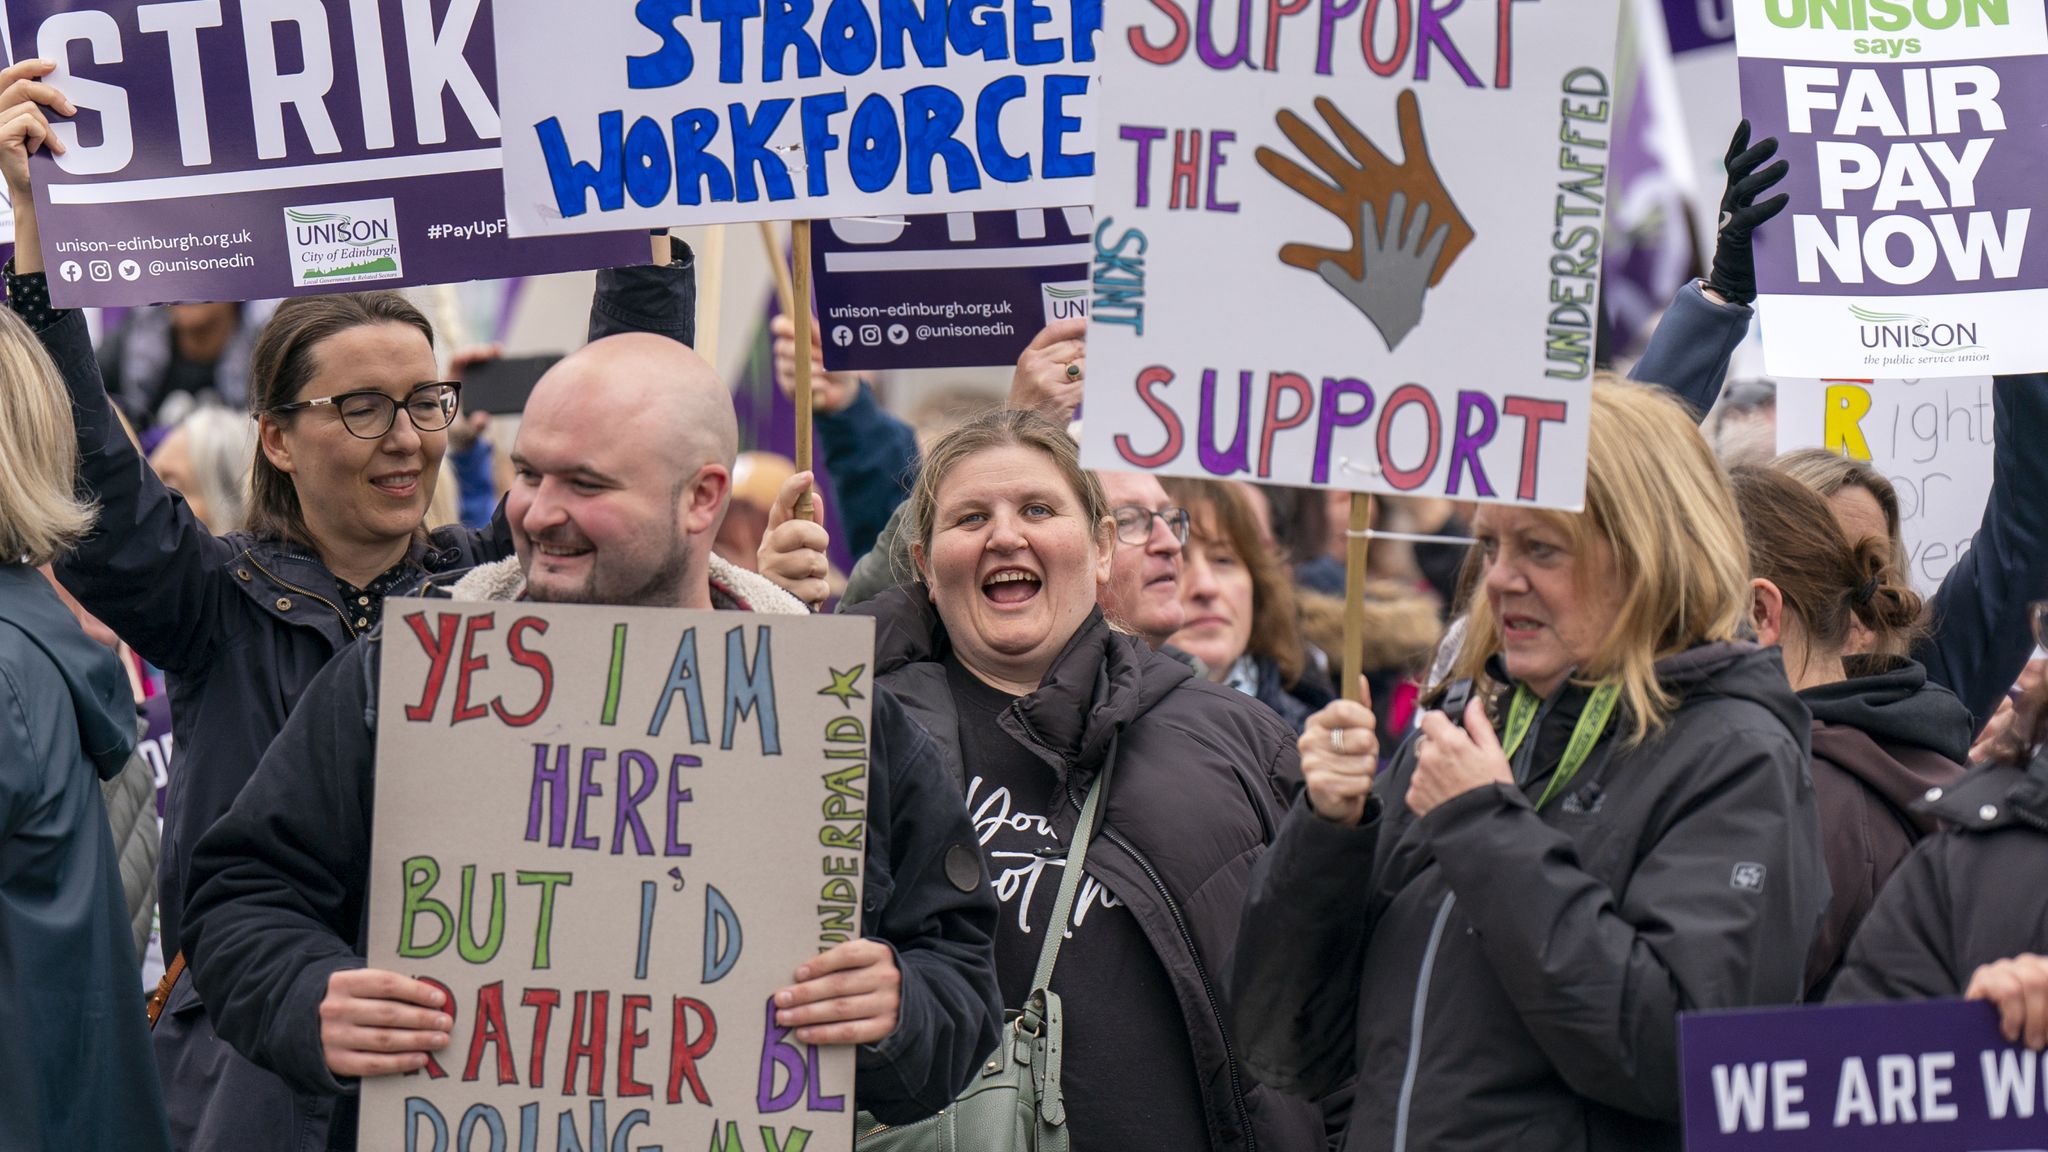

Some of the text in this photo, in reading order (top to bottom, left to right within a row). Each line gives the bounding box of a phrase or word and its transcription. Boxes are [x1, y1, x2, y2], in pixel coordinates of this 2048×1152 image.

[1127, 0, 1540, 89] SUPPORT
[1764, 0, 2009, 31] UNISON
[1854, 38, 1921, 58] says
[1783, 65, 2007, 136] FAIR
[533, 74, 1096, 218] WORKFORCE
[1119, 125, 1240, 213] THE
[1816, 137, 1995, 211] PAY
[56, 228, 253, 252] unison-edinburgh.org.uk
[296, 217, 389, 246] UNISON
[302, 244, 398, 264] City of Edinburgh
[1544, 66, 1610, 381] UNDERSTAFFED
[1793, 208, 2031, 285] NOW
[149, 253, 255, 276] @unisonedin
[1091, 217, 1148, 336] SKINT
[829, 300, 1013, 319] unison-edinburgh.org.uk
[916, 322, 1015, 340] @unisonedin
[1860, 322, 1977, 348] UNISON
[1863, 352, 1990, 367] the public service union
[1114, 364, 1568, 501] SUPPORT
[403, 612, 782, 756] YES I AM
[524, 743, 703, 857] HERE
[397, 855, 743, 984] BUT I'D
[1711, 1047, 2048, 1134] WE ARE W
